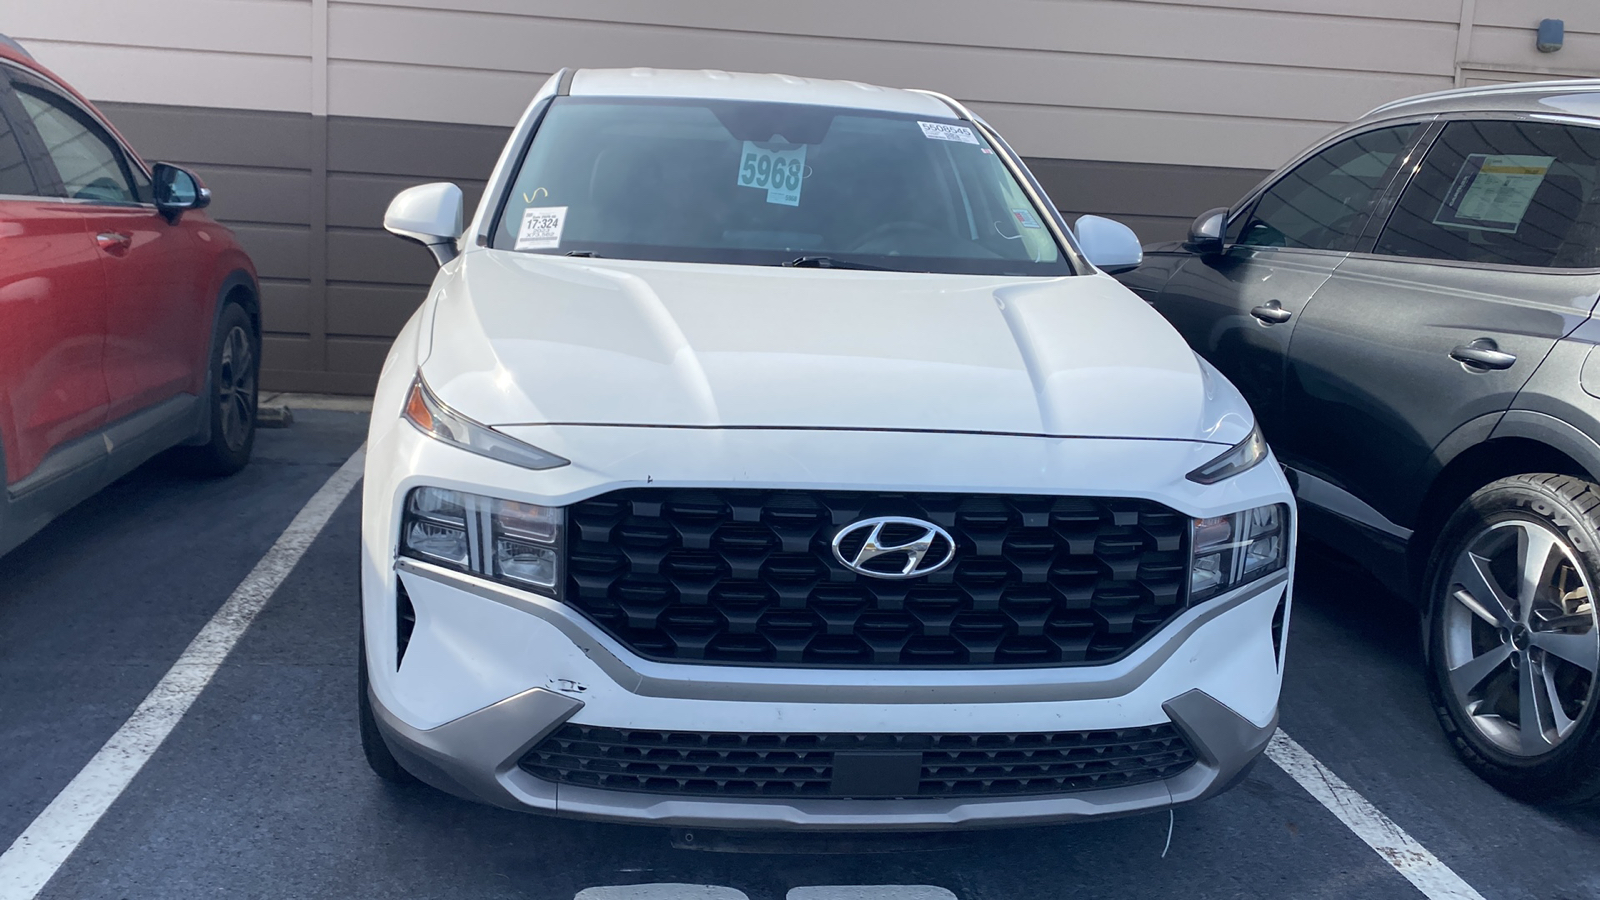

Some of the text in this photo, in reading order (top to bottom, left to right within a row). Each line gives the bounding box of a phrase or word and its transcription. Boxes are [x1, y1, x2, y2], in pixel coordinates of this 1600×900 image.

[922, 123, 971, 135] 5508545
[741, 153, 801, 191] 5968
[1514, 492, 1588, 553] TOYO
